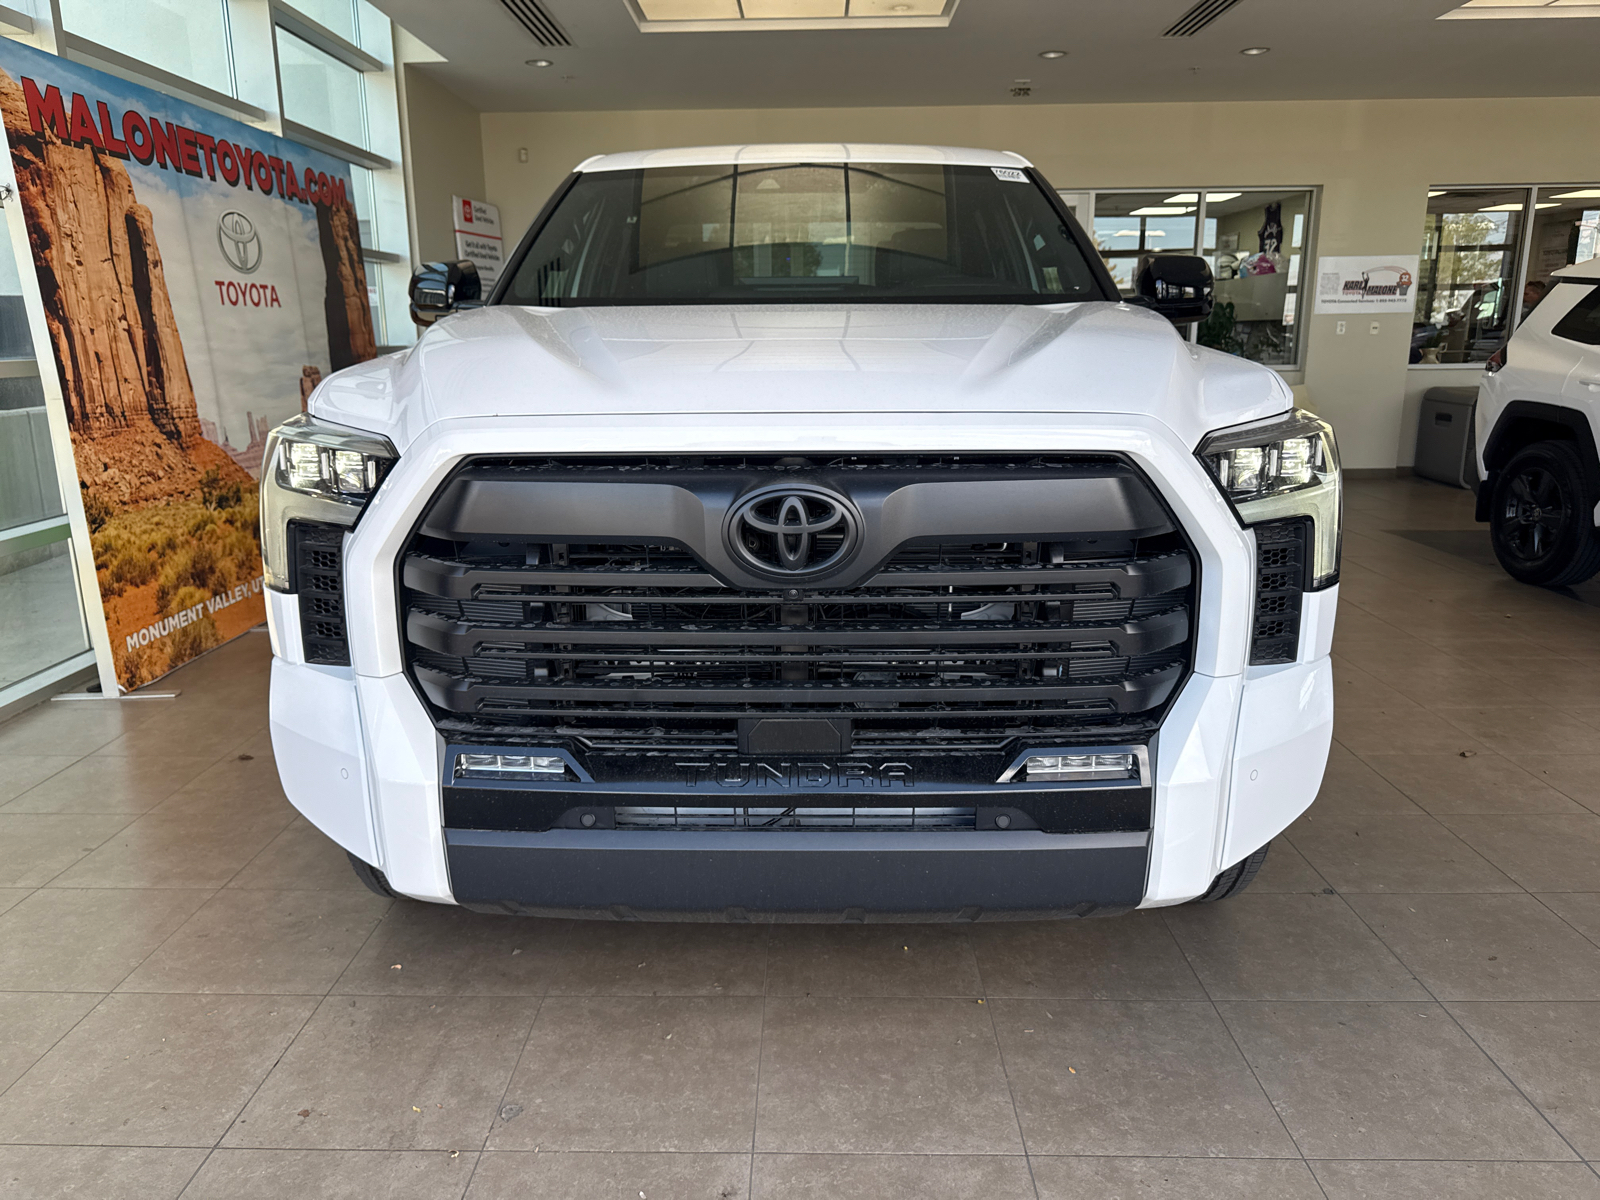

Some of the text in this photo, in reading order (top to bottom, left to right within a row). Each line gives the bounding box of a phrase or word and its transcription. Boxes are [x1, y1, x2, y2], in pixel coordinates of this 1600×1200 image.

[20, 76, 348, 209] MALONETOYOTA.COM
[214, 280, 282, 308] TOYOTA
[1343, 280, 1398, 296] KARL MALONE
[126, 603, 203, 652] MONUMENT
[205, 582, 251, 614] VALLEY,
[675, 763, 915, 787] TUNDRA
